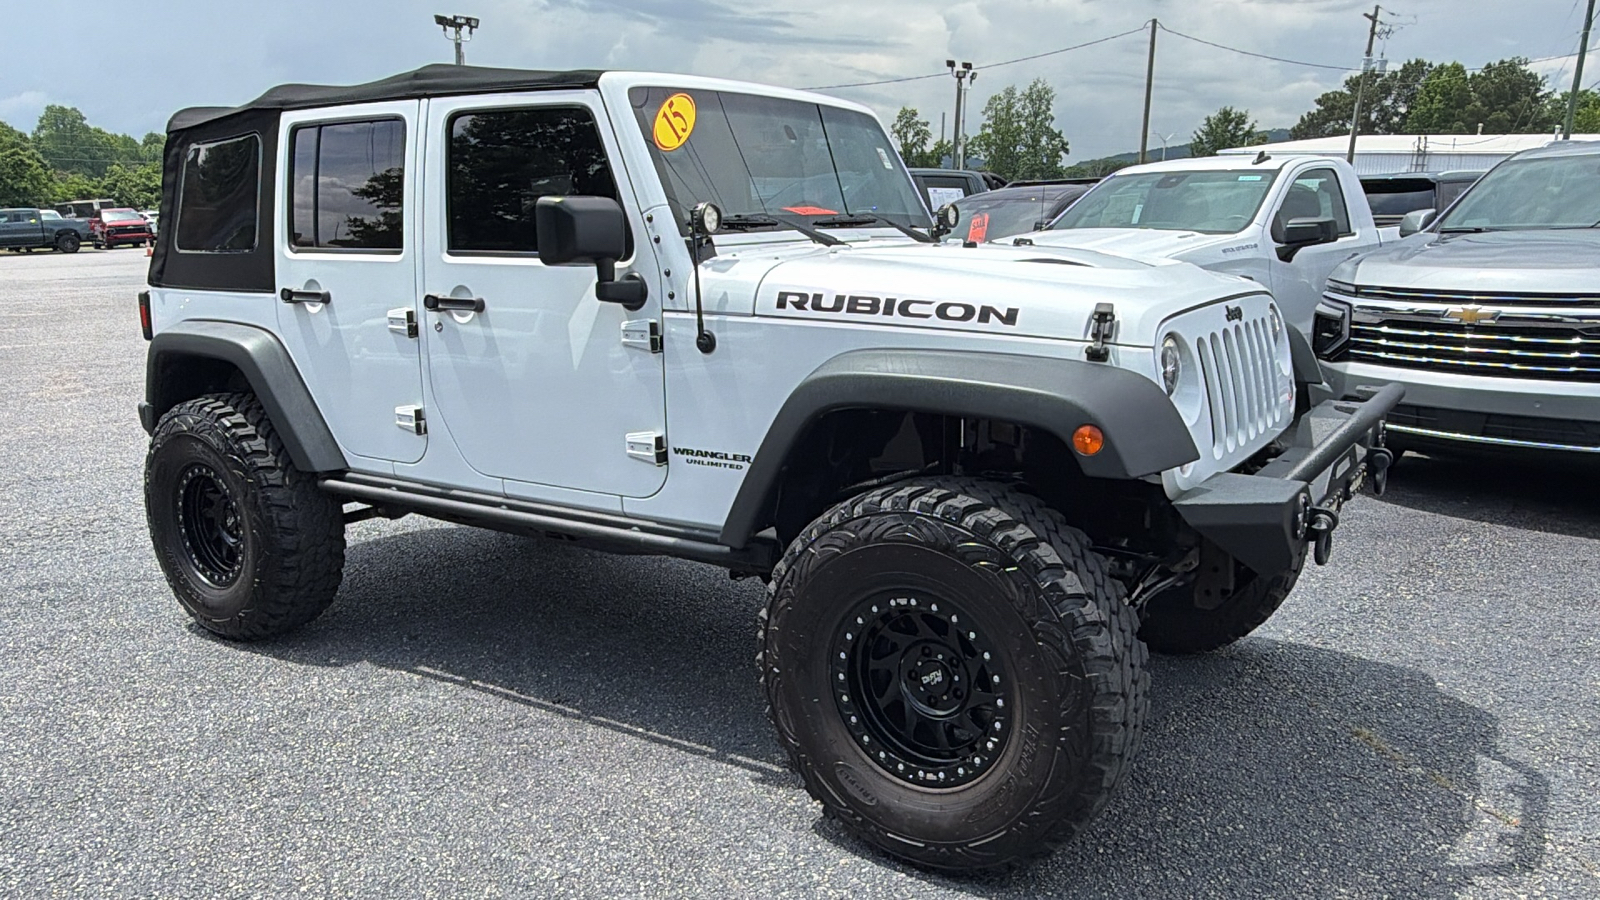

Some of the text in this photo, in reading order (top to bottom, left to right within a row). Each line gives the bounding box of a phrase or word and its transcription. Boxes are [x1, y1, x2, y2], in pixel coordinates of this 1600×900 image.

[662, 100, 688, 143] 15
[776, 291, 1020, 327] RUBICON
[1225, 305, 1243, 322] Jeep
[673, 447, 752, 464] WRANGLER
[686, 458, 743, 470] UNLIMITED
